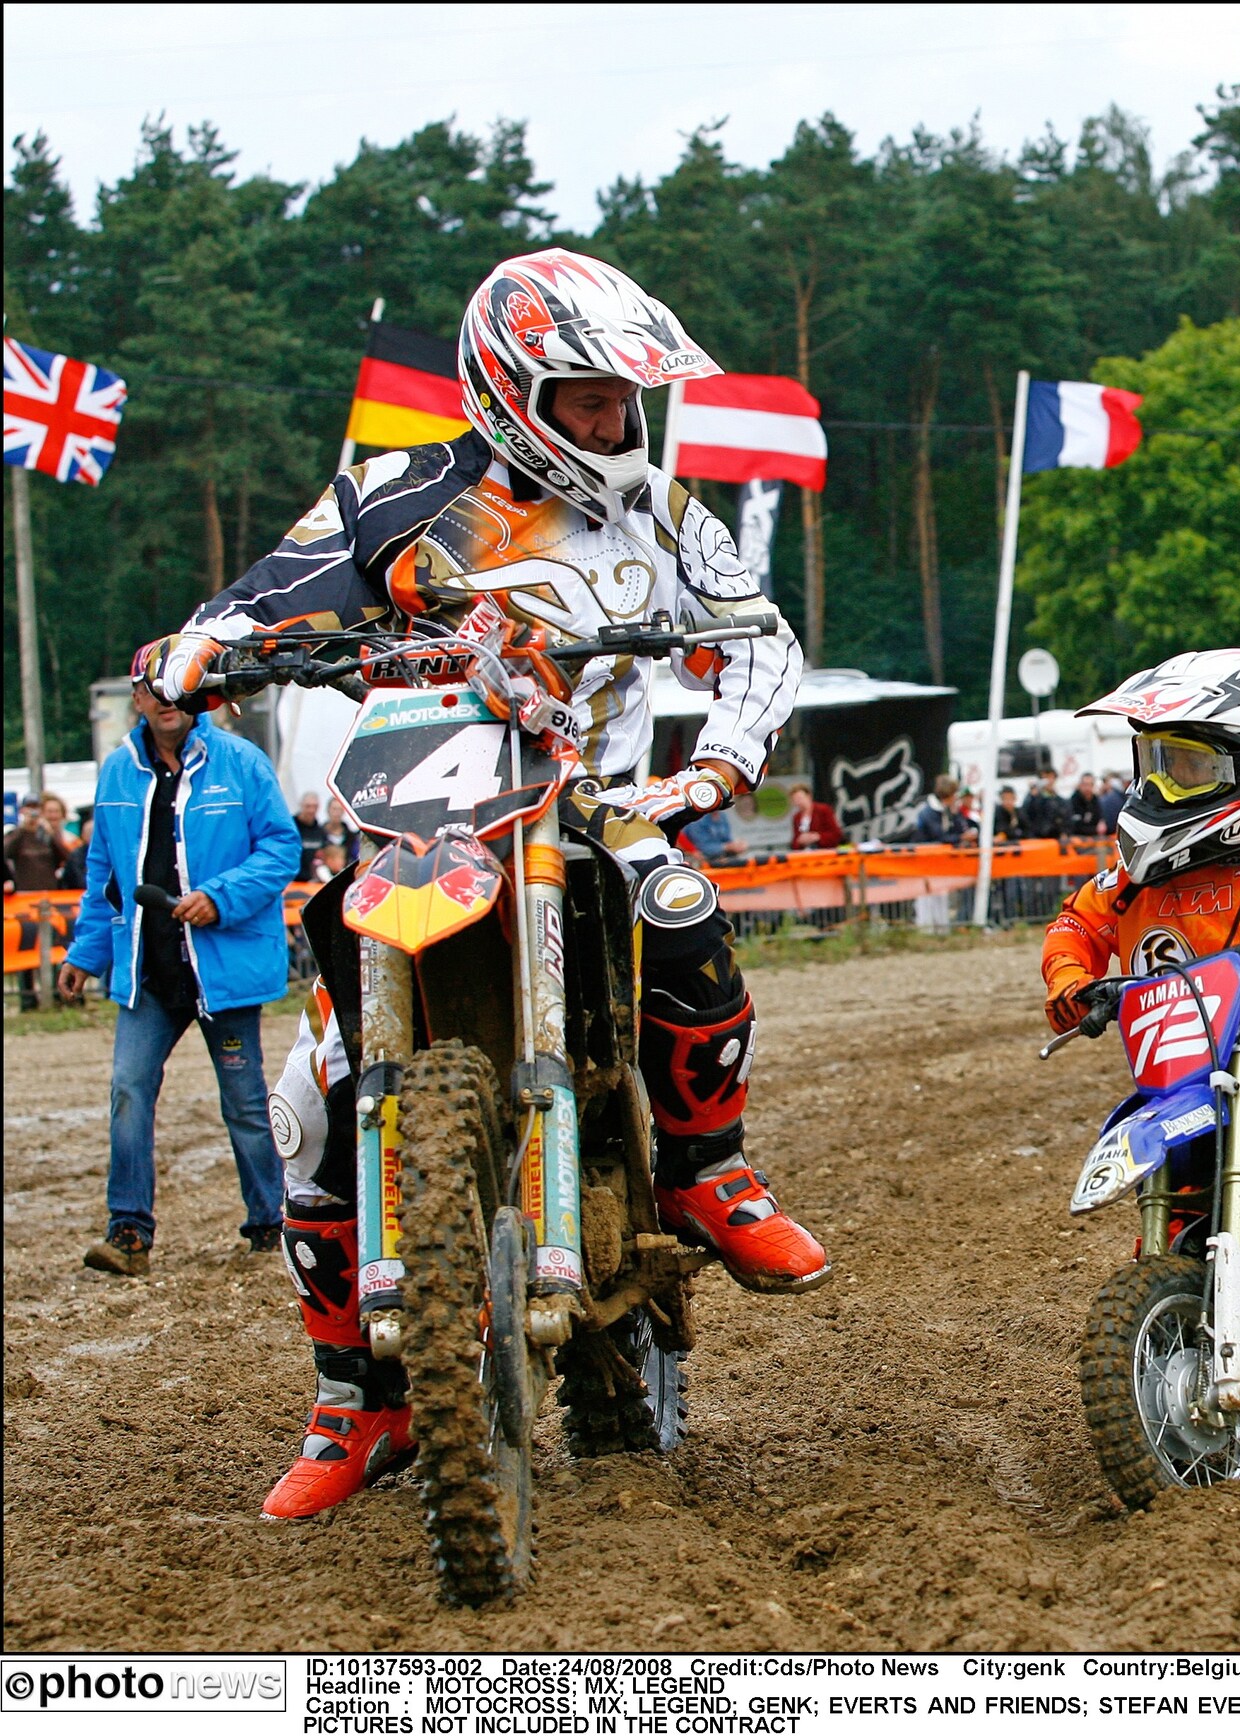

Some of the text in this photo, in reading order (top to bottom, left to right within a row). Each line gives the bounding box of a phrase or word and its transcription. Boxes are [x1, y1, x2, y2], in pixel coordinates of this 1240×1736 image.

[664, 350, 709, 372] LAZER
[497, 419, 547, 468] LAZER
[390, 703, 482, 728] MOTOREX
[390, 723, 508, 812] 4
[1168, 847, 1191, 870] 72
[1158, 882, 1232, 917] KTM
[1139, 975, 1205, 1011] YAMAHA
[1129, 995, 1222, 1079] 72
[535, 1264, 582, 1284] rembo
